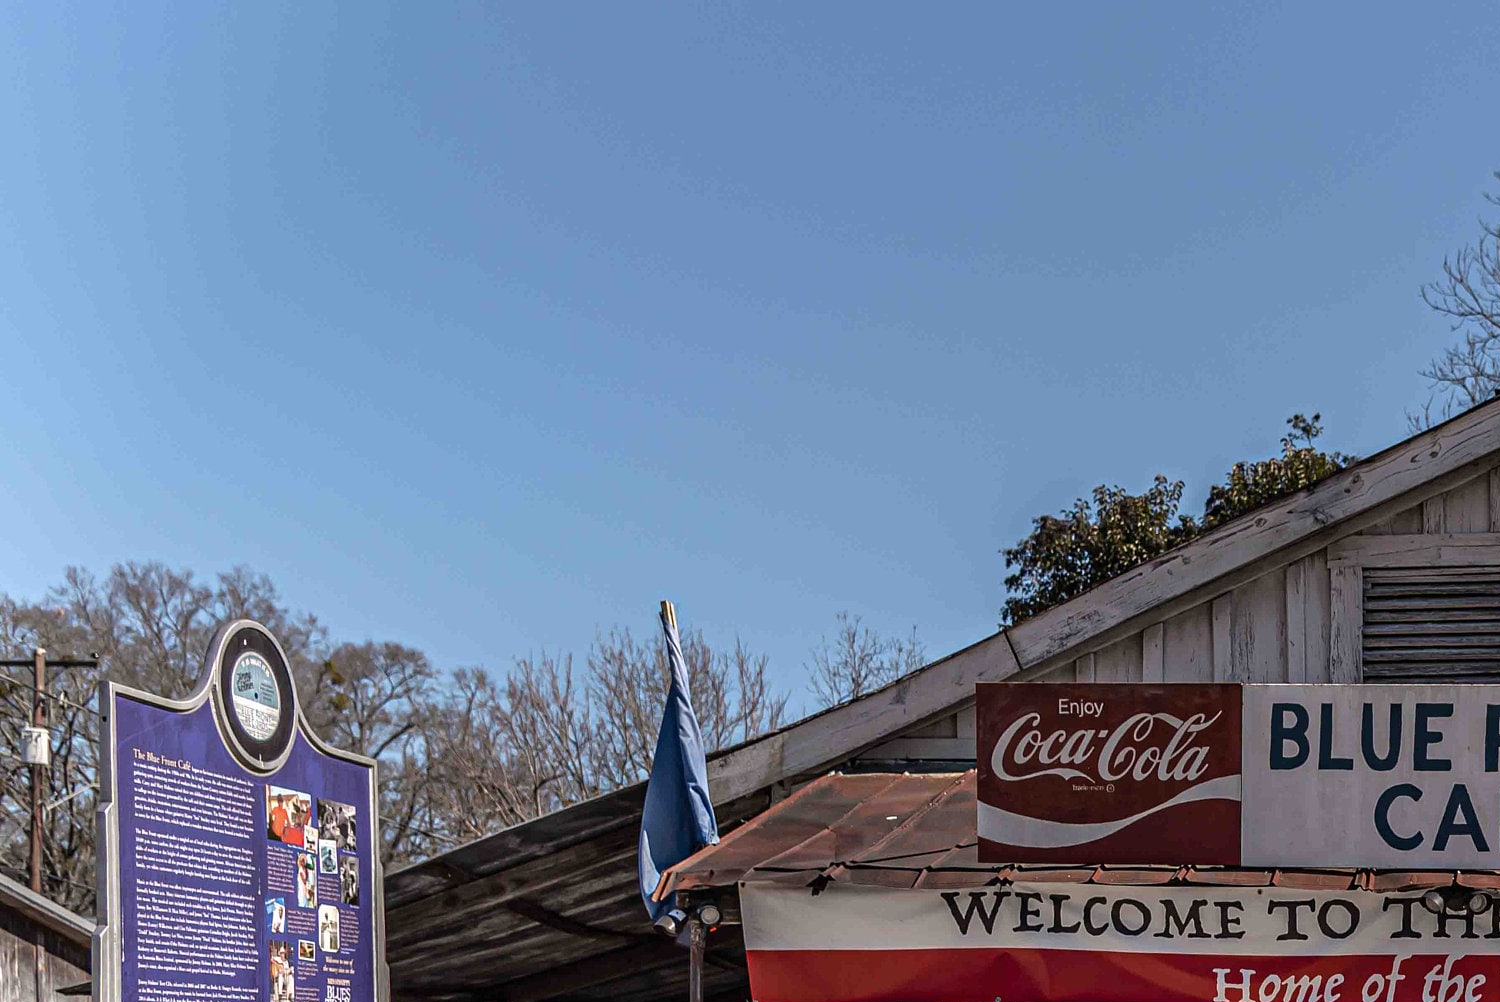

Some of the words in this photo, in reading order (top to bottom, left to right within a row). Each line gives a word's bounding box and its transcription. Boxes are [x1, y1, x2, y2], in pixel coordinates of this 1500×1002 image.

[1059, 699, 1104, 718] Enjoy
[991, 711, 1223, 784] Coca-Cola
[1270, 703, 1453, 771] BLUE
[133, 748, 145, 760] The
[146, 752, 160, 763] Blue
[161, 755, 177, 767] Front
[178, 760, 191, 770] Café
[941, 891, 1246, 939] WELCOME
[1268, 898, 1361, 941] TO
[327, 986, 351, 1000] BLUES
